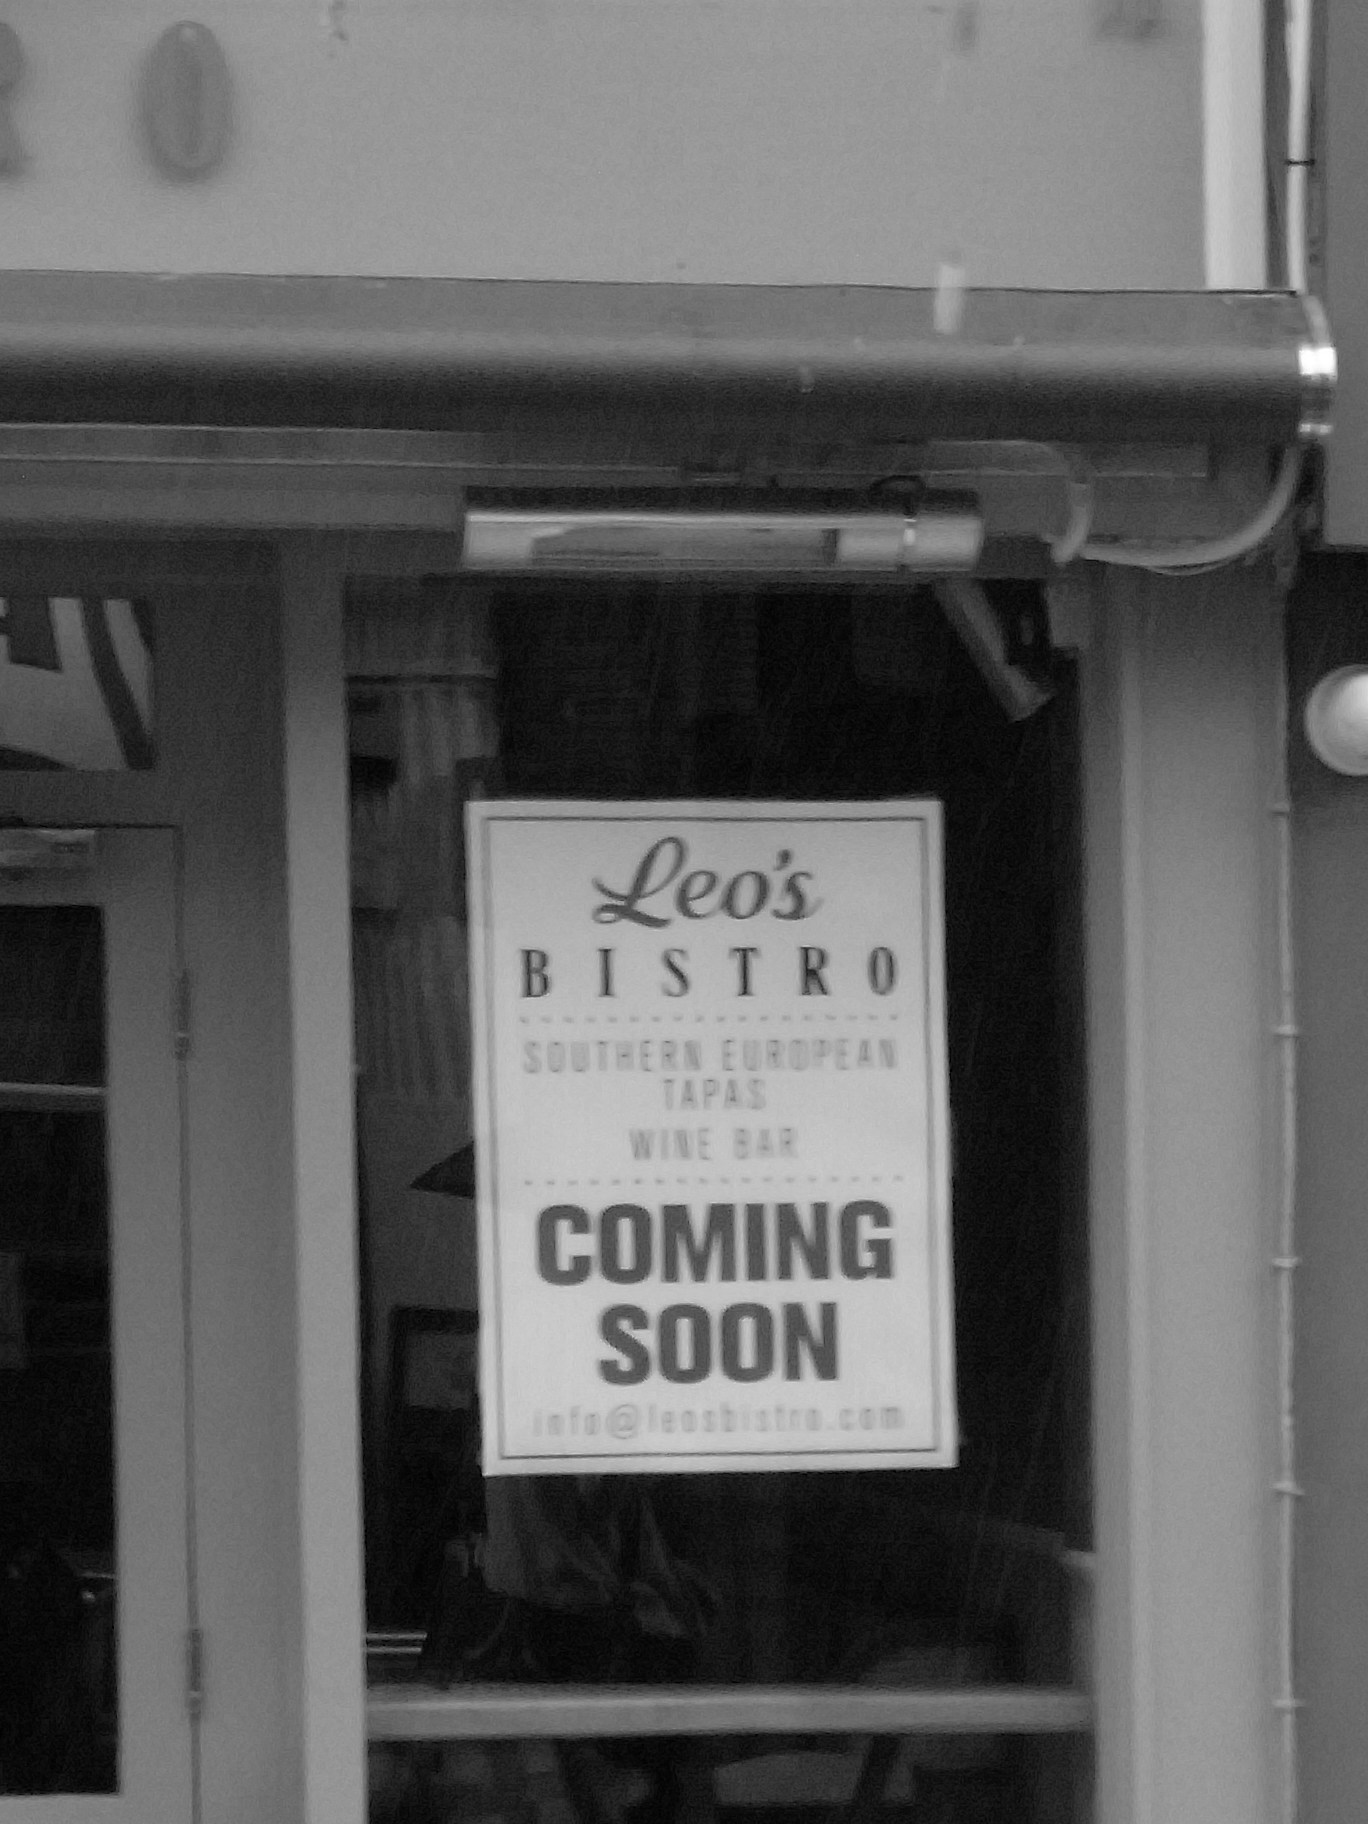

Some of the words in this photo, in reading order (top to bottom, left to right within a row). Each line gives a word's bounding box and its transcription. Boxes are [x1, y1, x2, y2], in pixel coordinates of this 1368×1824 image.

[591, 835, 823, 928] Leo's
[519, 945, 898, 998] BISTRO
[523, 1039, 701, 1074] SOUTHERN
[721, 1038, 899, 1072] EUROPEAN
[663, 1078, 767, 1111] TAPAS
[628, 1127, 713, 1161] WINE
[732, 1127, 799, 1160] BAR
[536, 1200, 894, 1287] COMING
[597, 1301, 839, 1386] SOON
[532, 1401, 906, 1440] info@leosbistro.com
